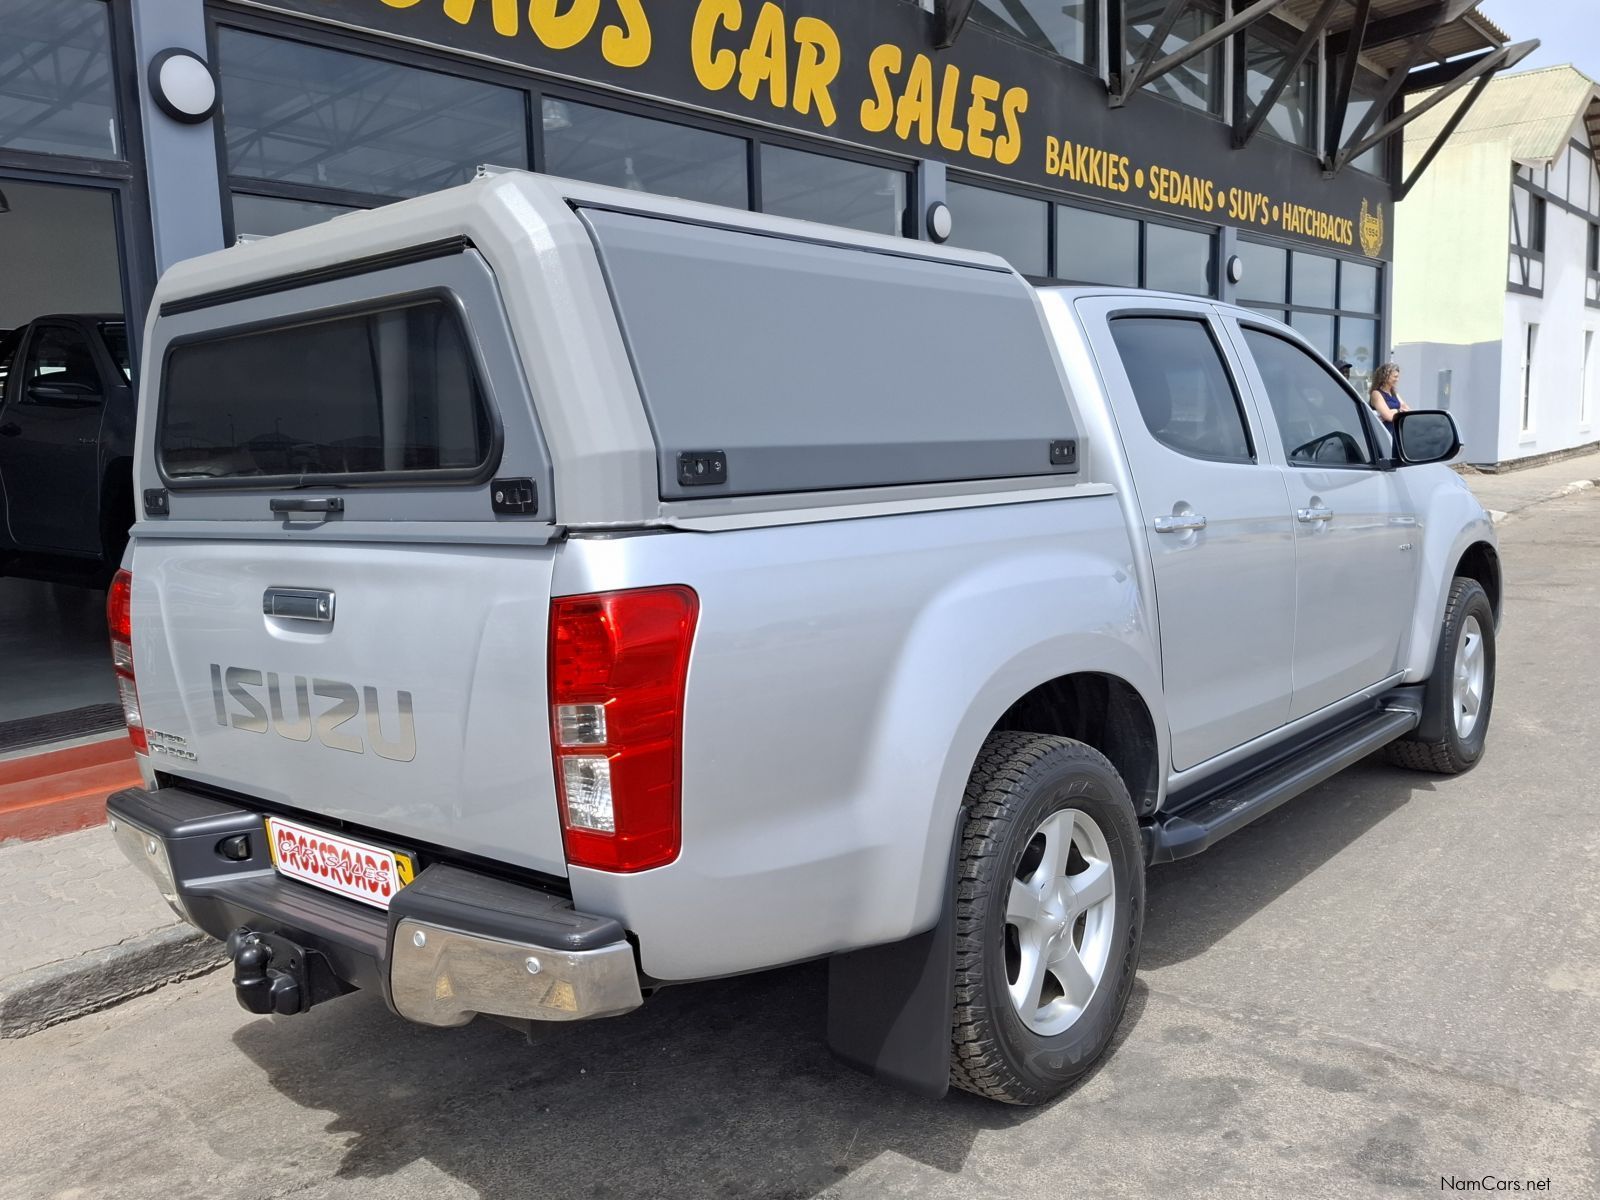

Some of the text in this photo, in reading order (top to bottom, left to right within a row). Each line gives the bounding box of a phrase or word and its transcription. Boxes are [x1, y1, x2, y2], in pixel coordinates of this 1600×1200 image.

[690, 0, 842, 128] CAR
[859, 43, 1029, 165] SALES
[1045, 135, 1353, 246] BAKKIES SEDANS SUV'S HATCHBACKS
[210, 663, 417, 763] ISUZU
[277, 829, 392, 898] CROSSROADS
[279, 840, 315, 861] CAR
[324, 855, 389, 883] SALES
